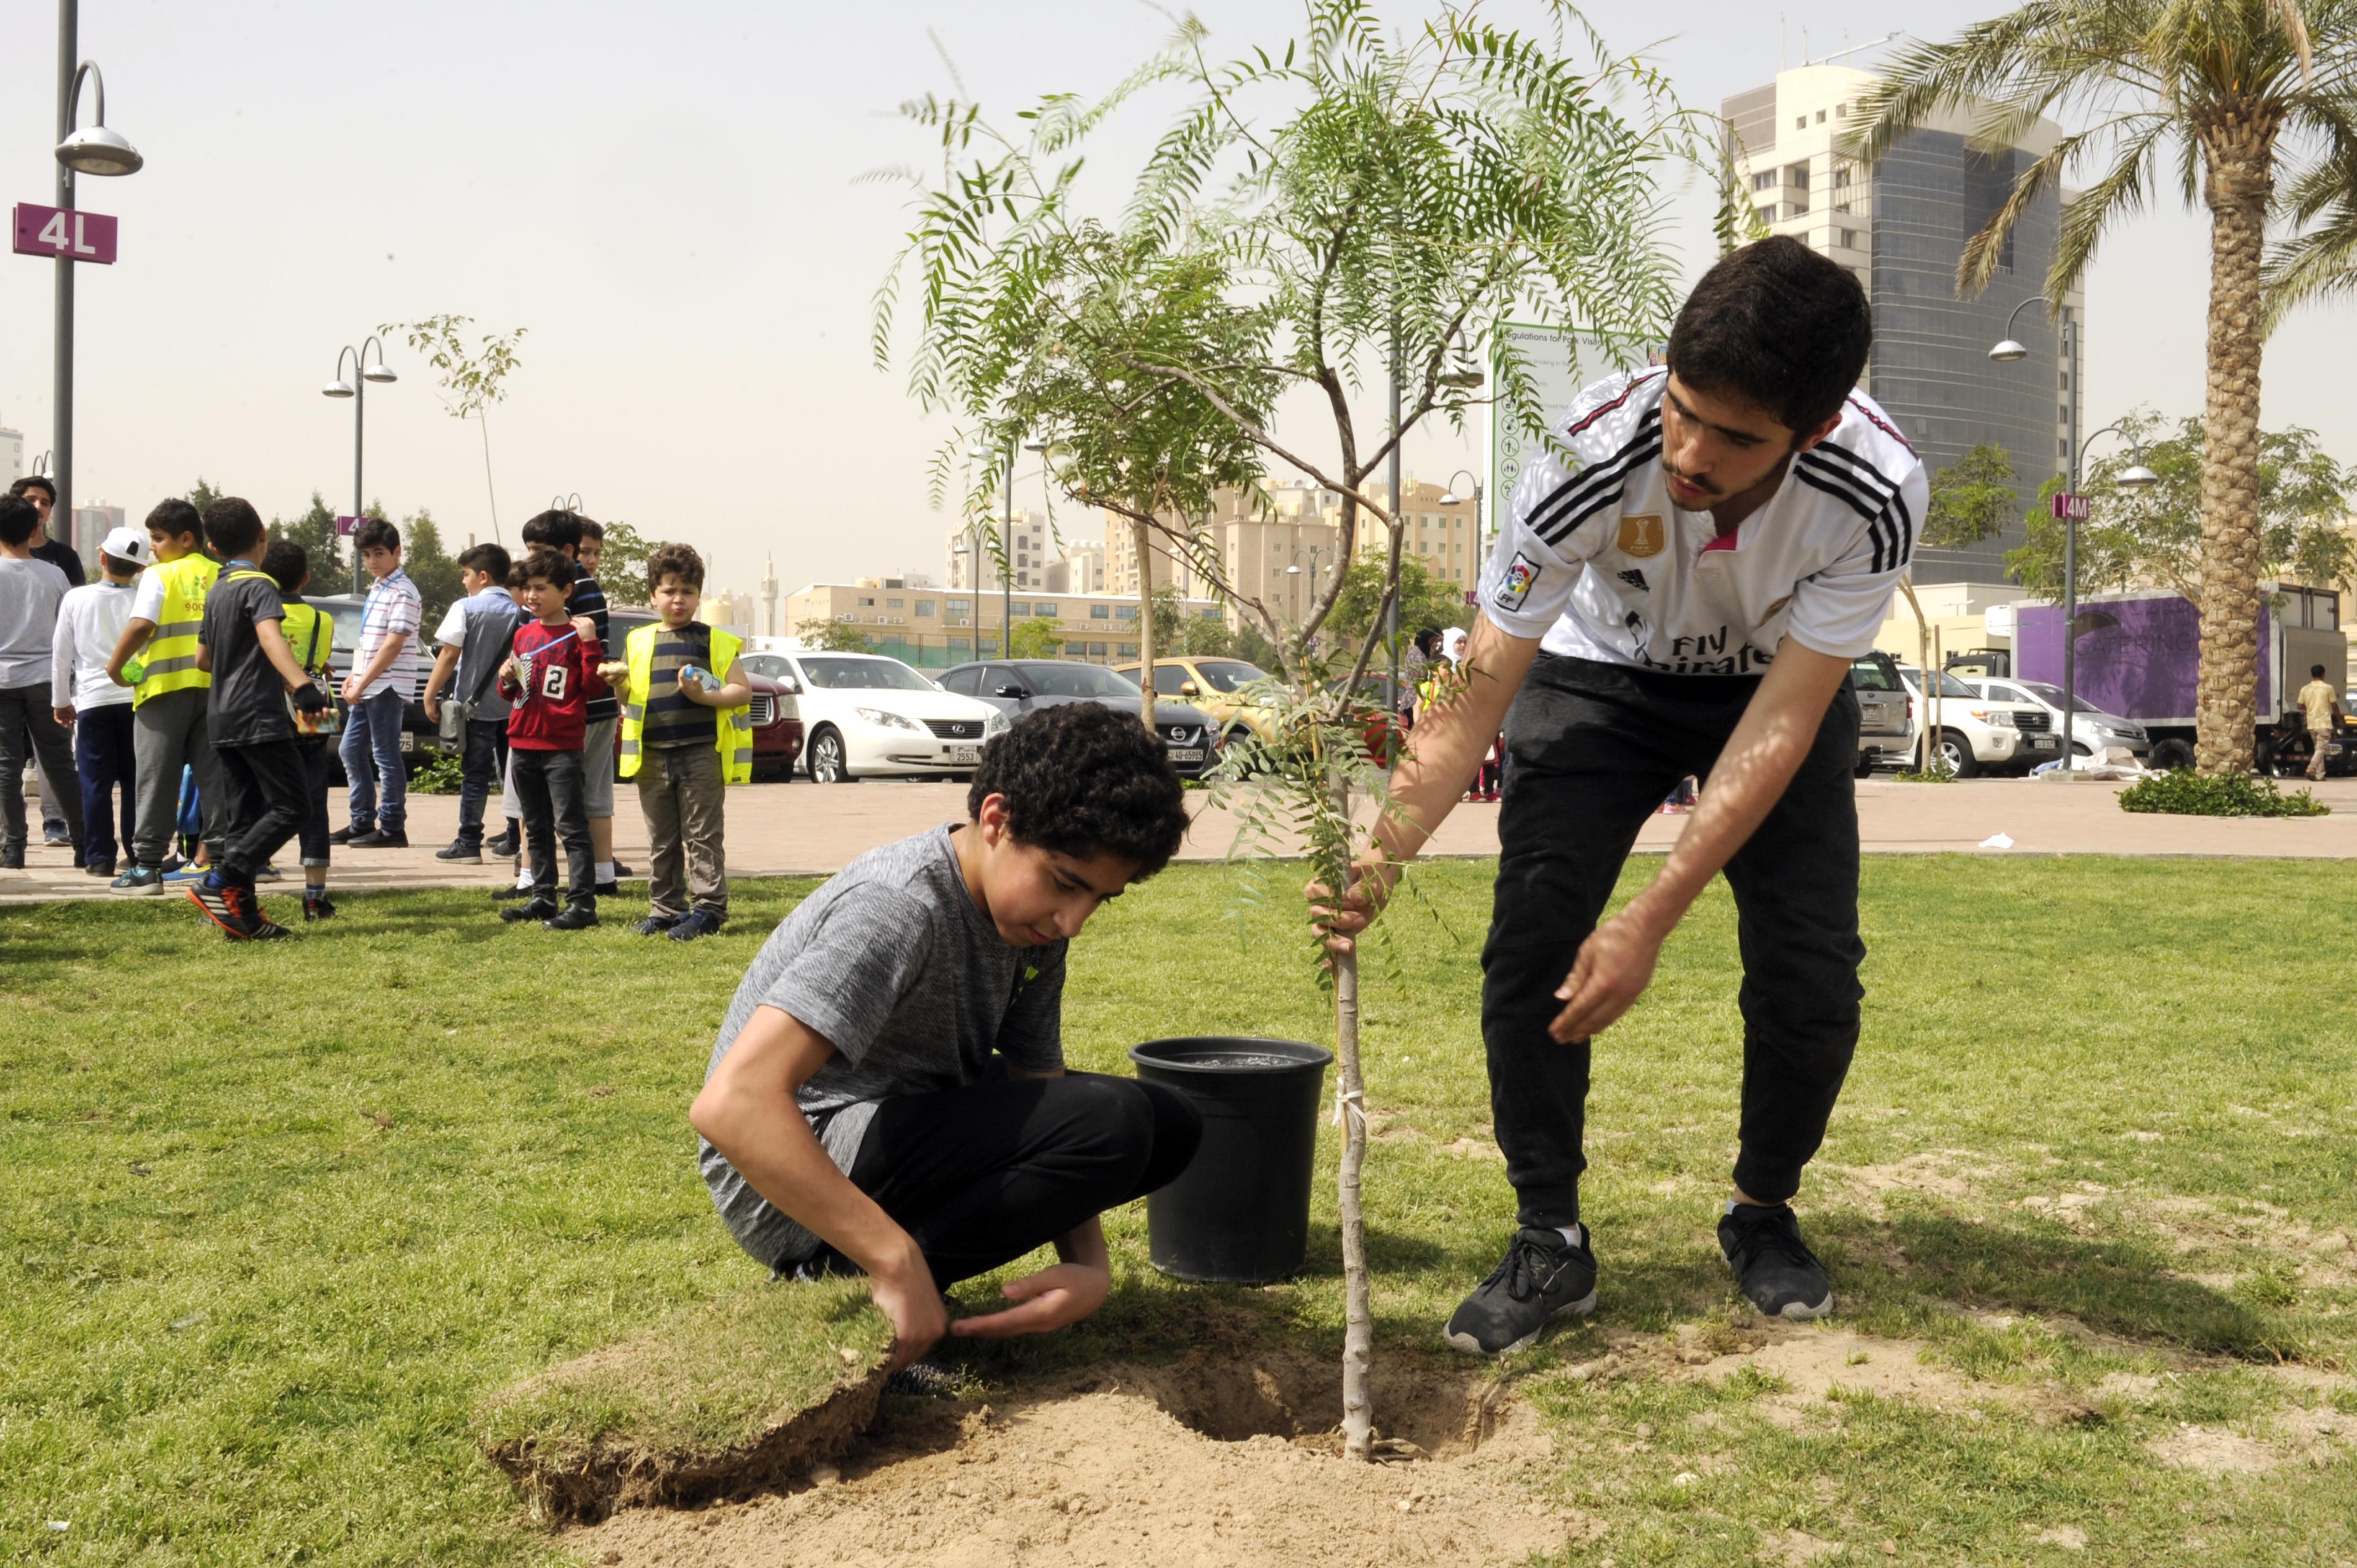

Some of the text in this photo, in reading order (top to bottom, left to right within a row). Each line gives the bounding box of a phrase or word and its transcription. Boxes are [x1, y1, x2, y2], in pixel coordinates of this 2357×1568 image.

[38, 211, 96, 255] 4L
[1502, 332, 1547, 341] egulations
[2067, 497, 2087, 518] 4M
[547, 670, 562, 695] 2
[957, 752, 974, 761] 2553
